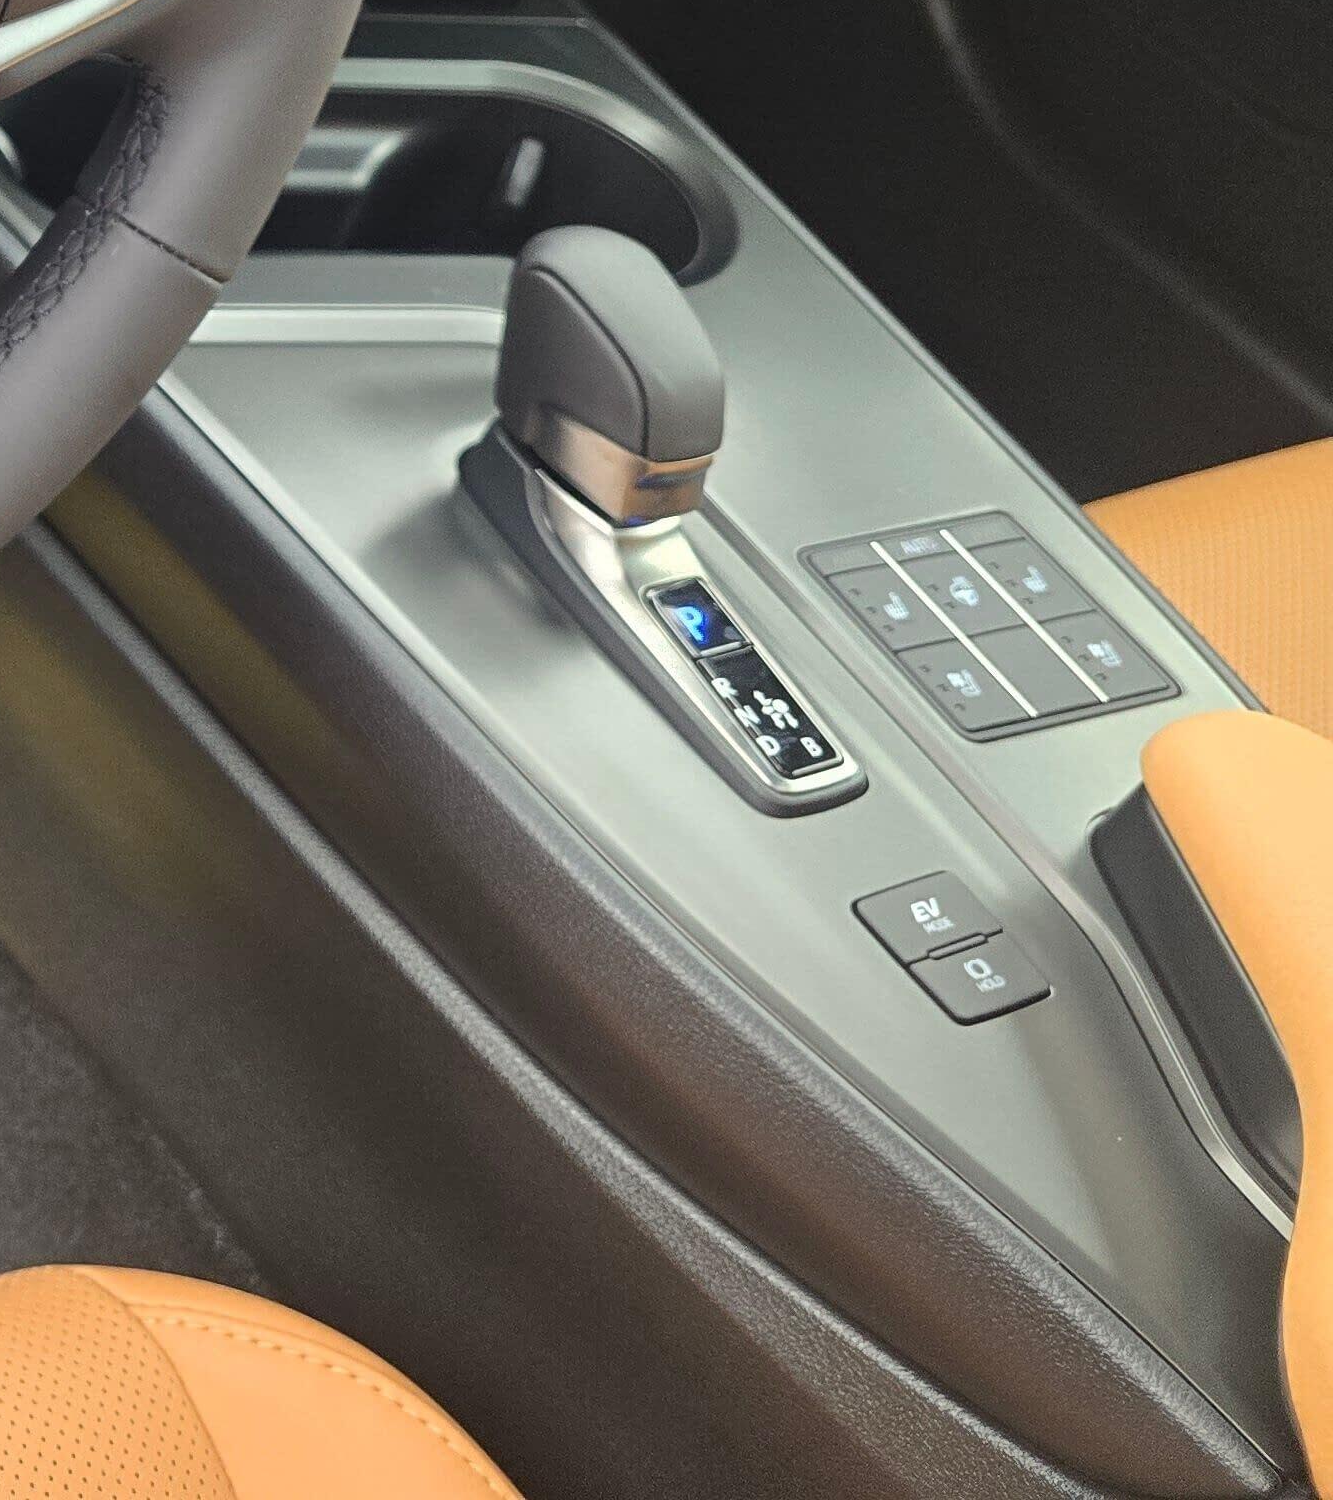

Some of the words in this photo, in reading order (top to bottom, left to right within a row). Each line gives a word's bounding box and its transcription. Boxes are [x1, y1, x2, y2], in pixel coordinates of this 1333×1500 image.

[675, 606, 705, 643] P
[710, 677, 739, 698] R
[734, 704, 761, 728] N
[756, 735, 781, 757] D
[800, 736, 824, 758] B
[910, 897, 941, 923] EV
